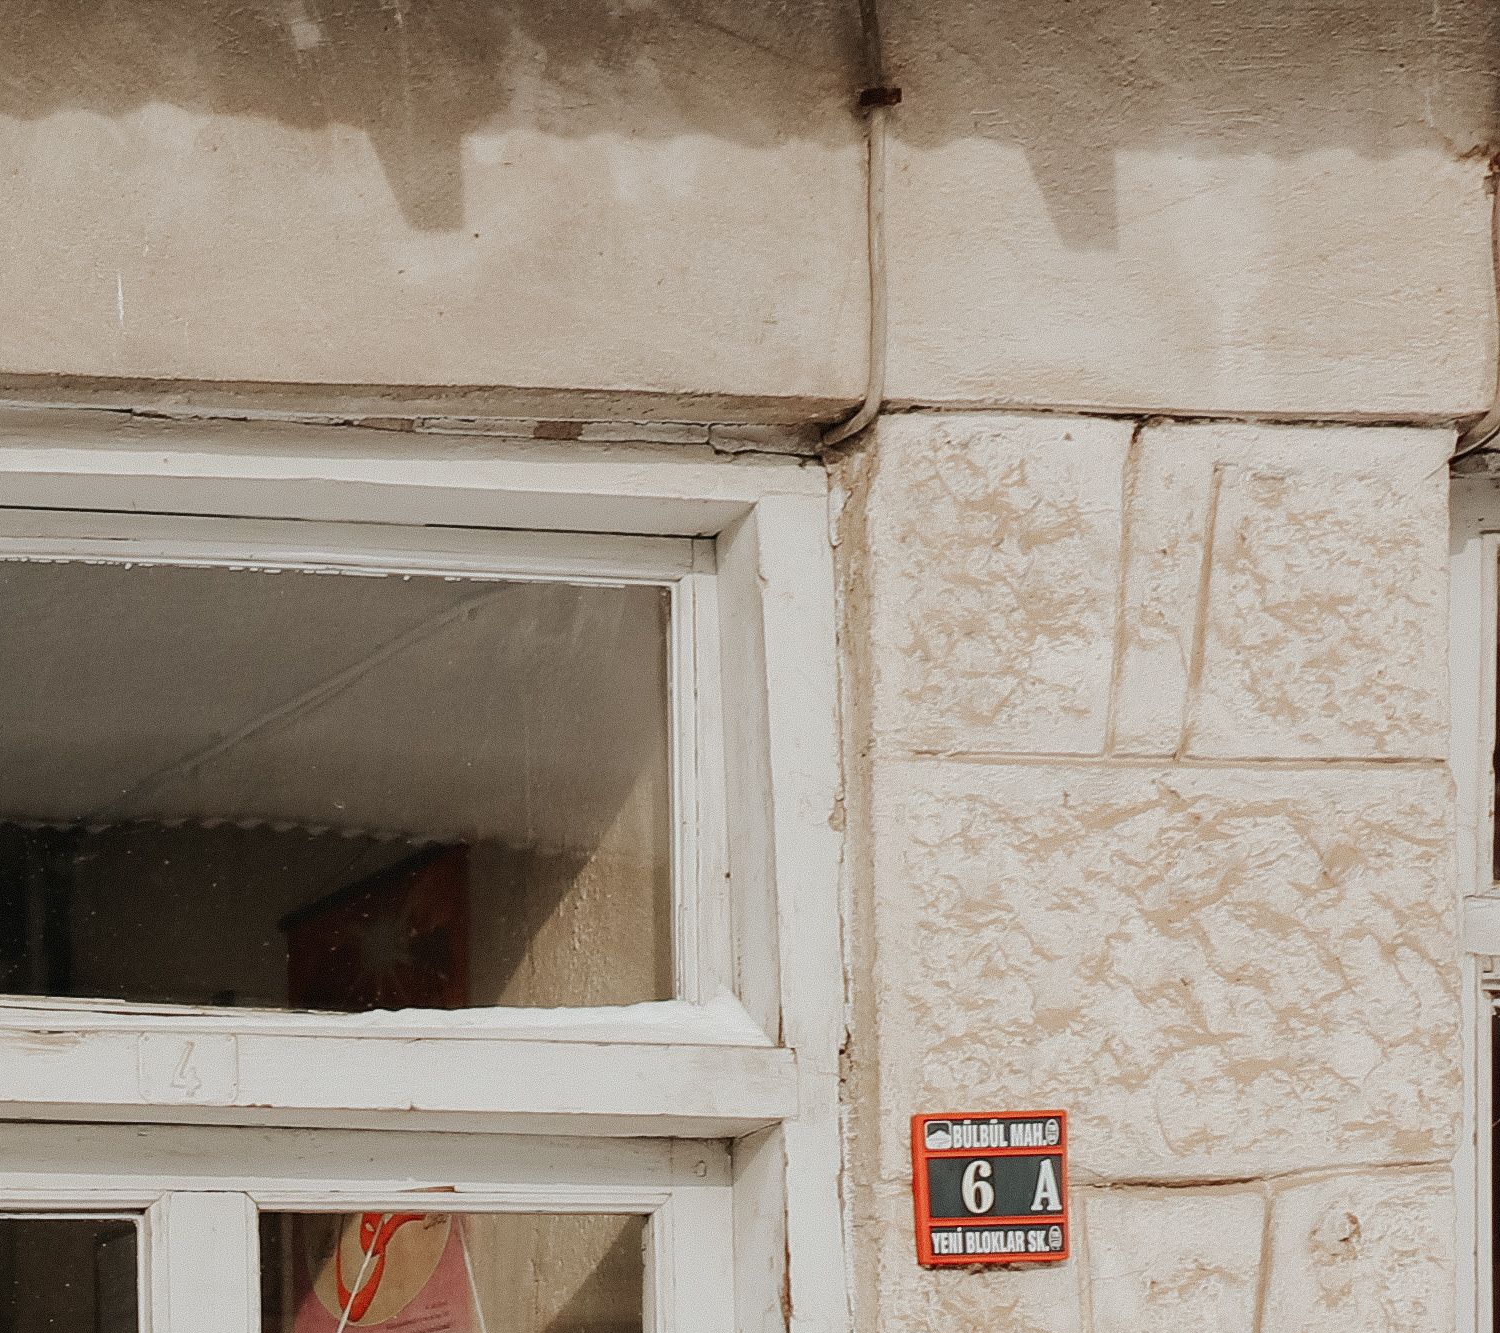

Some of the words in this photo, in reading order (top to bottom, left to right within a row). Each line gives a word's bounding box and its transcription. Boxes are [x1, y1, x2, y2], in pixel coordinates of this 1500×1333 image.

[952, 1119, 1008, 1148] BÜLBÜL
[1009, 1122, 1047, 1147] MAH.
[961, 1160, 994, 1214] 6
[1030, 1158, 1063, 1211] A
[931, 1226, 963, 1254] YENİ
[965, 1230, 1026, 1254] BLOKLAR
[1026, 1230, 1050, 1253] SK.
